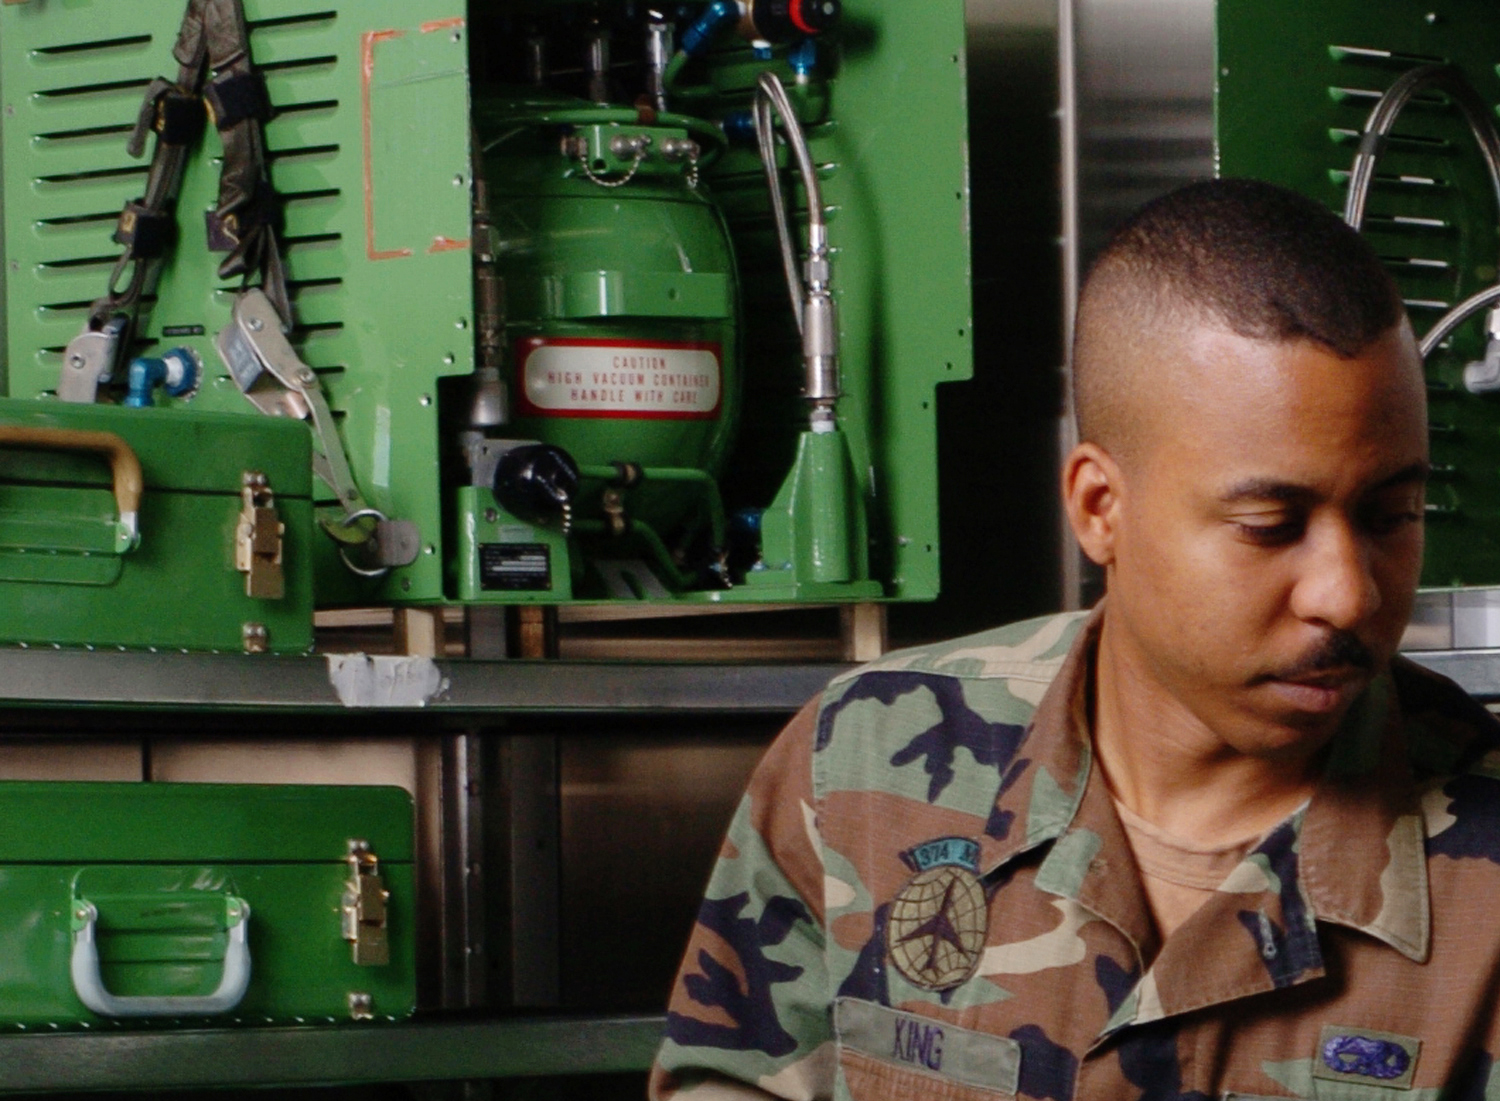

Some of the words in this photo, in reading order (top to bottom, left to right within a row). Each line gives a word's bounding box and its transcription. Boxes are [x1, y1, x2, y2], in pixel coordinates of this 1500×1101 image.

[613, 356, 667, 370] CAUTION
[548, 372, 582, 385] HIGH
[593, 372, 645, 386] VACUUM
[653, 374, 710, 388] CONTAINER
[570, 389, 625, 403] HANDLE
[634, 390, 664, 402] WITH
[673, 390, 698, 404] CARE
[894, 1017, 945, 1072] KING
